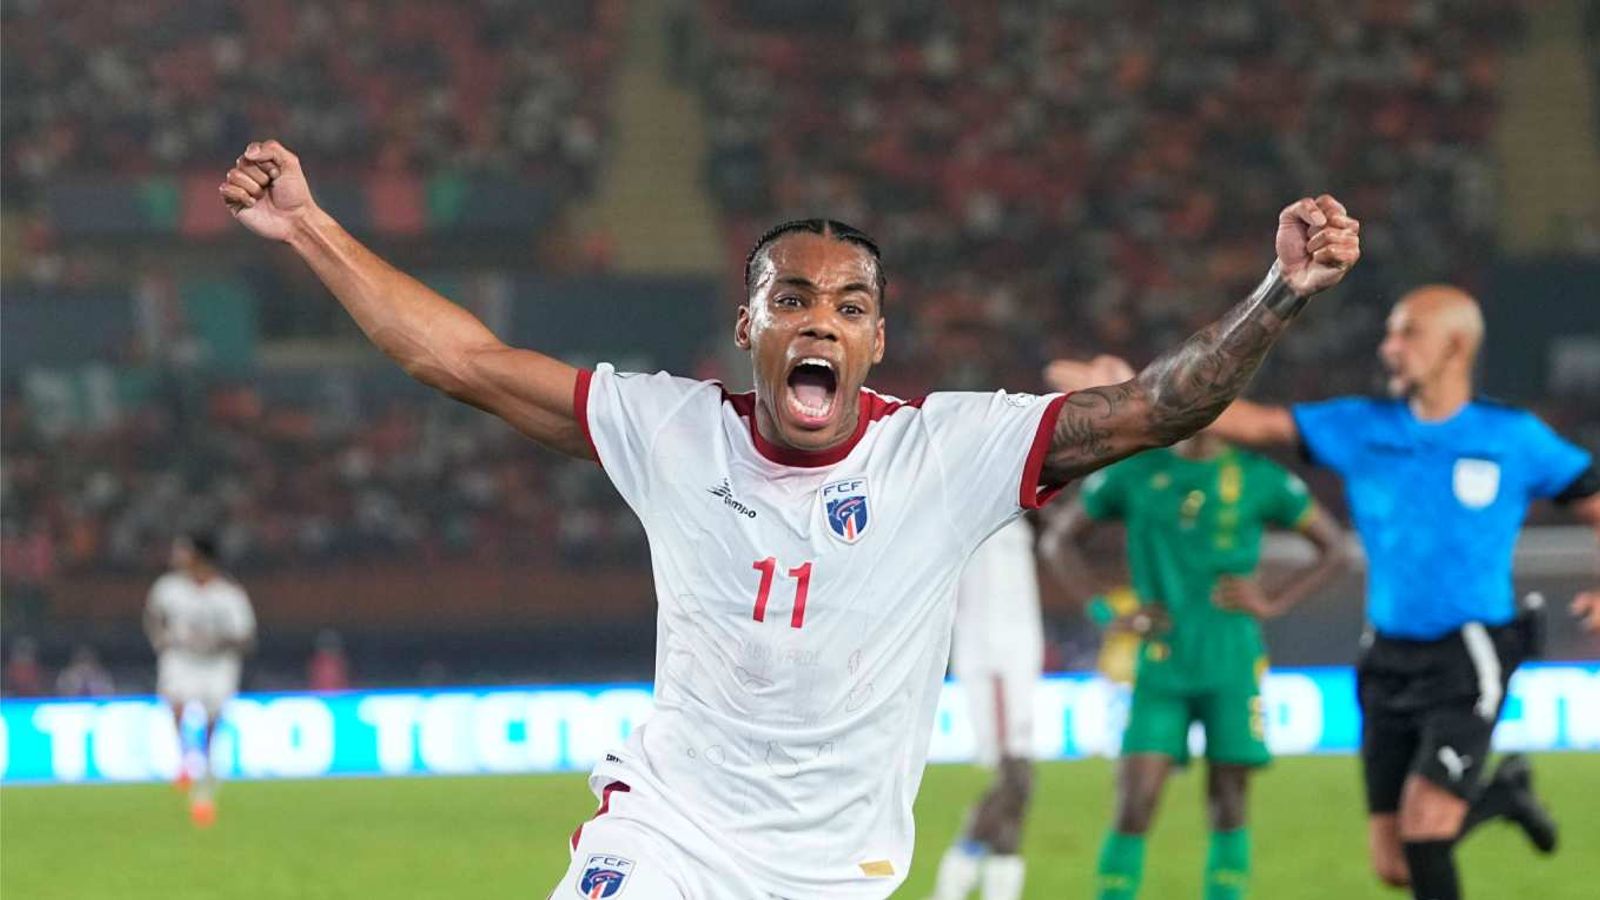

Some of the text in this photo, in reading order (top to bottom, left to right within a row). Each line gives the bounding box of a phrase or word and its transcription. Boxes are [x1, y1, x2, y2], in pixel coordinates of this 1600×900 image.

[823, 480, 863, 497] FCF
[723, 494, 757, 519] tempo
[752, 556, 813, 629] 11
[589, 855, 631, 867] FCF
